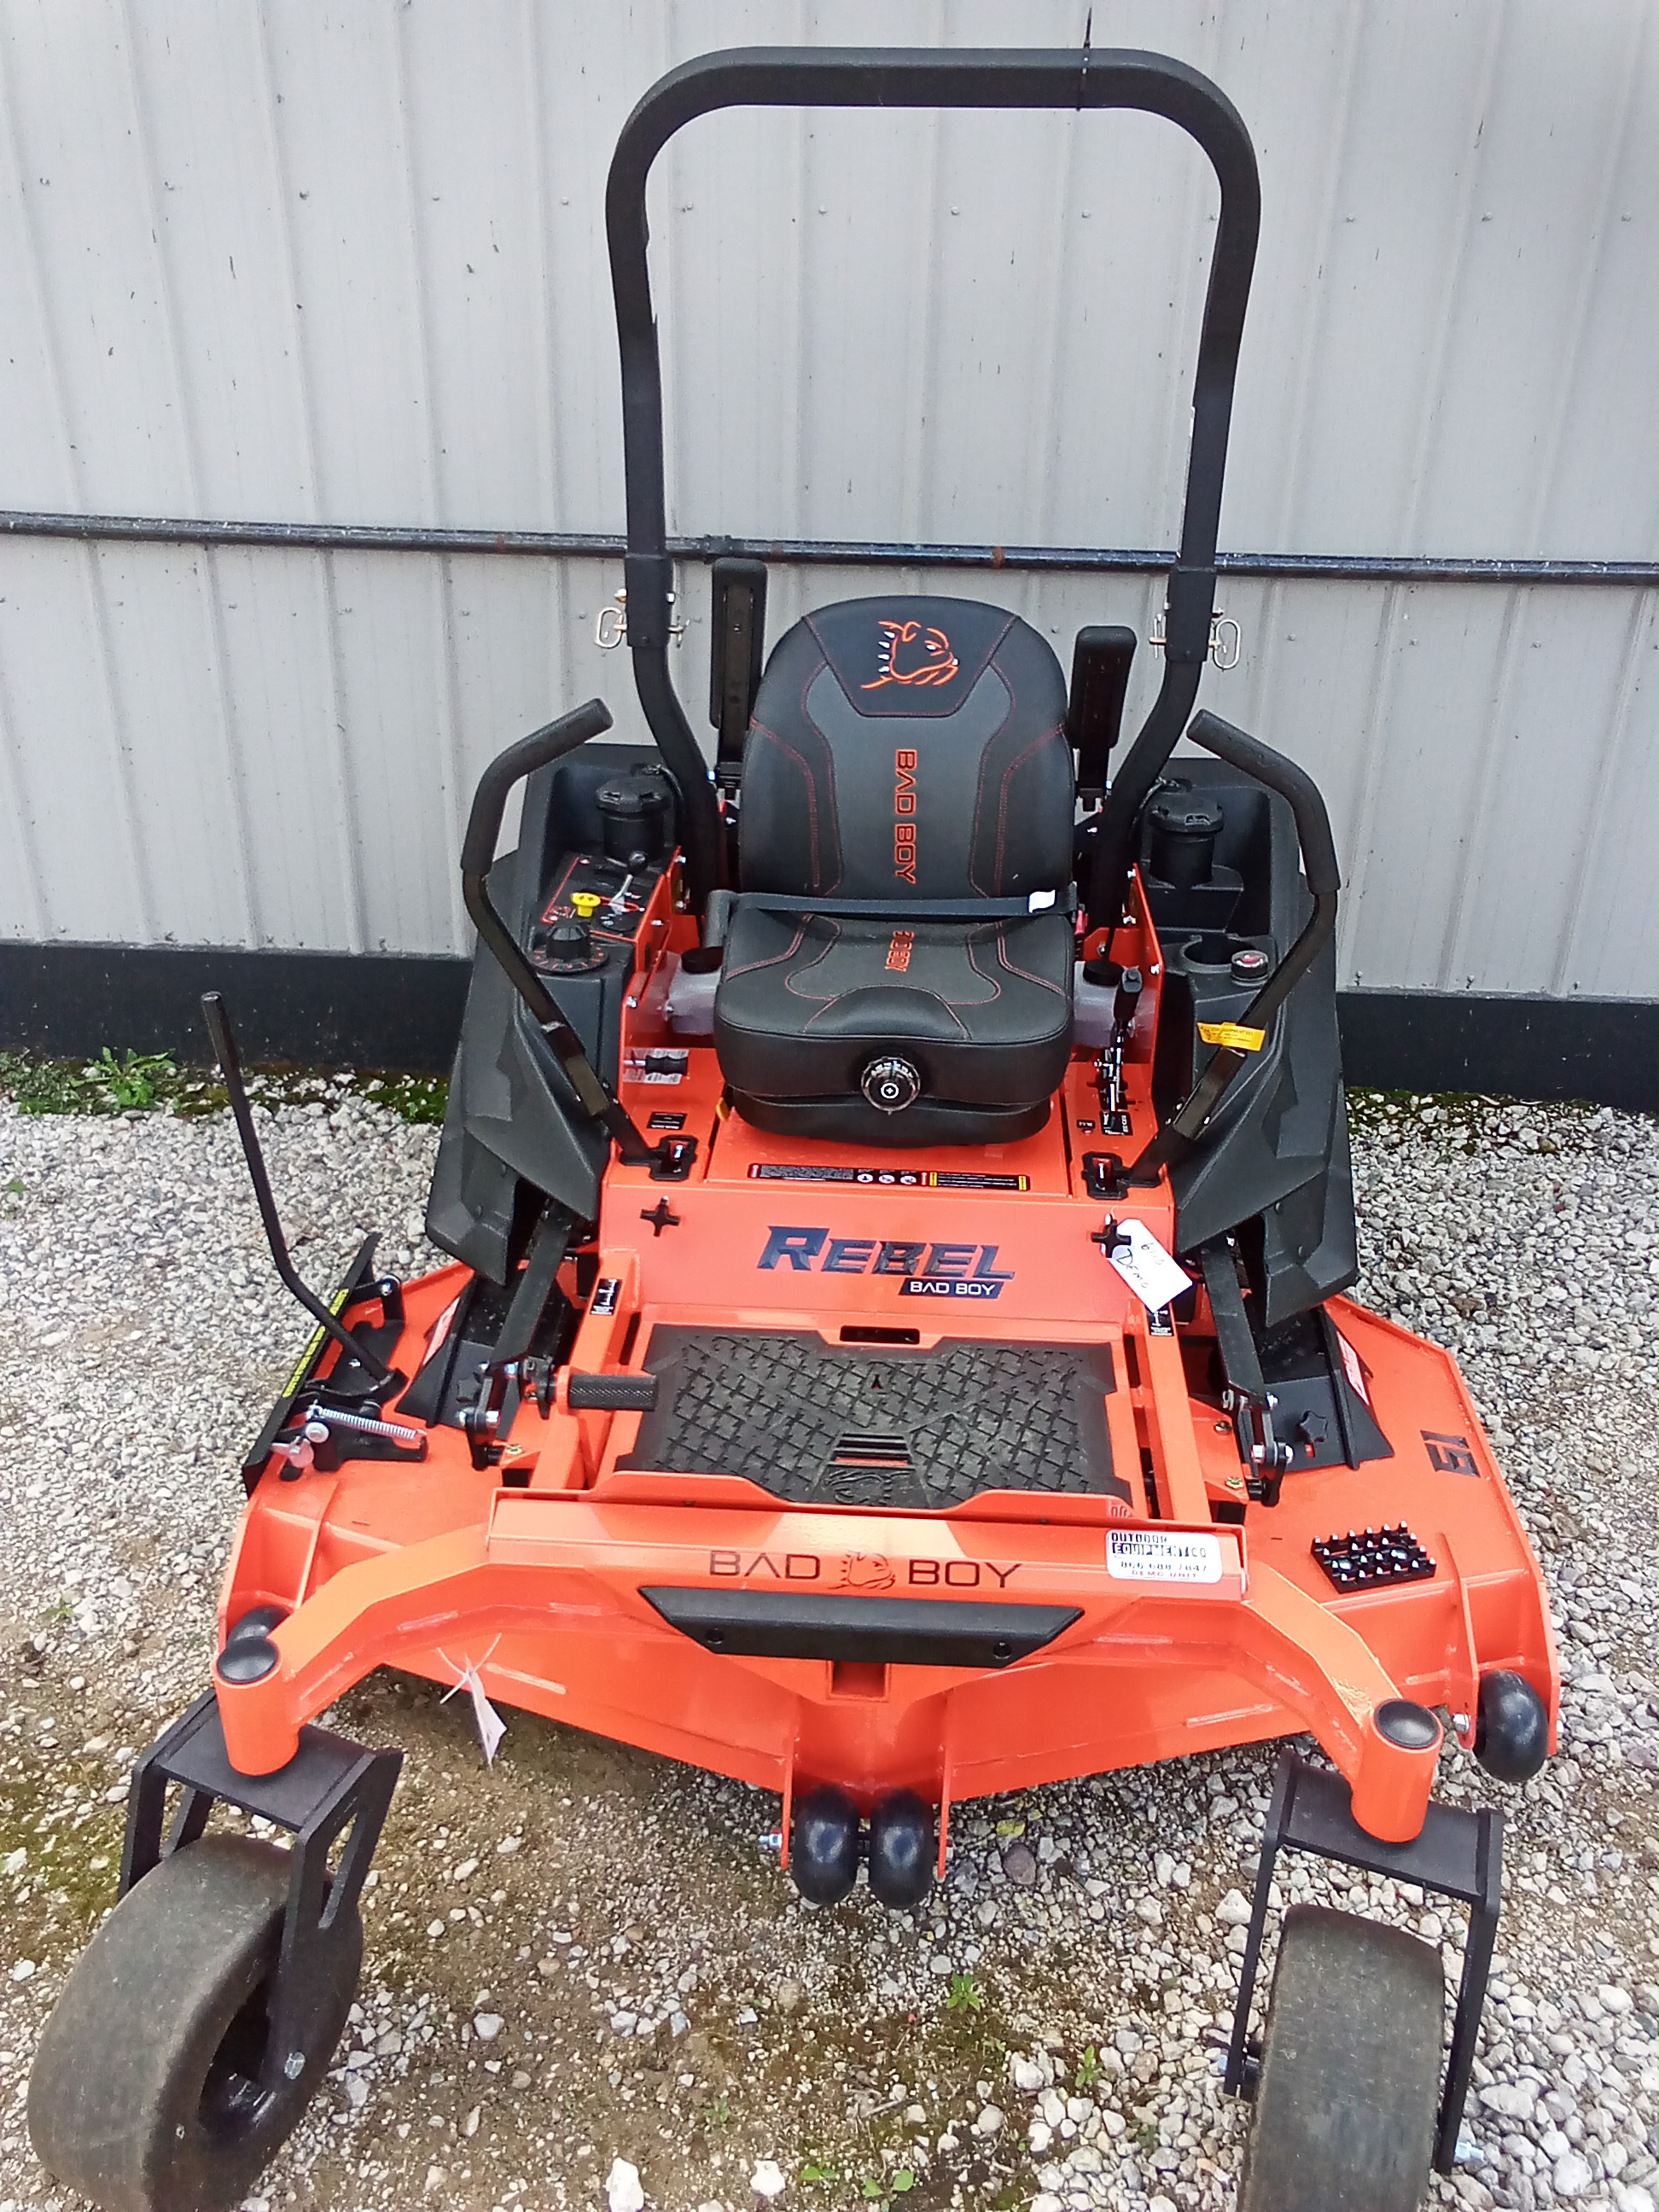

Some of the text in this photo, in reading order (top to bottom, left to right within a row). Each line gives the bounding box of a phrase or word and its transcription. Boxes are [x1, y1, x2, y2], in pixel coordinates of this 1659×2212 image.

[894, 749, 917, 884] BAD BOY
[757, 1225, 1016, 1280] REBEL
[910, 1281, 996, 1295] BAD BOY
[1111, 1533, 1167, 1543] OUTDOOR
[709, 1551, 1022, 1588] BAD BOY
